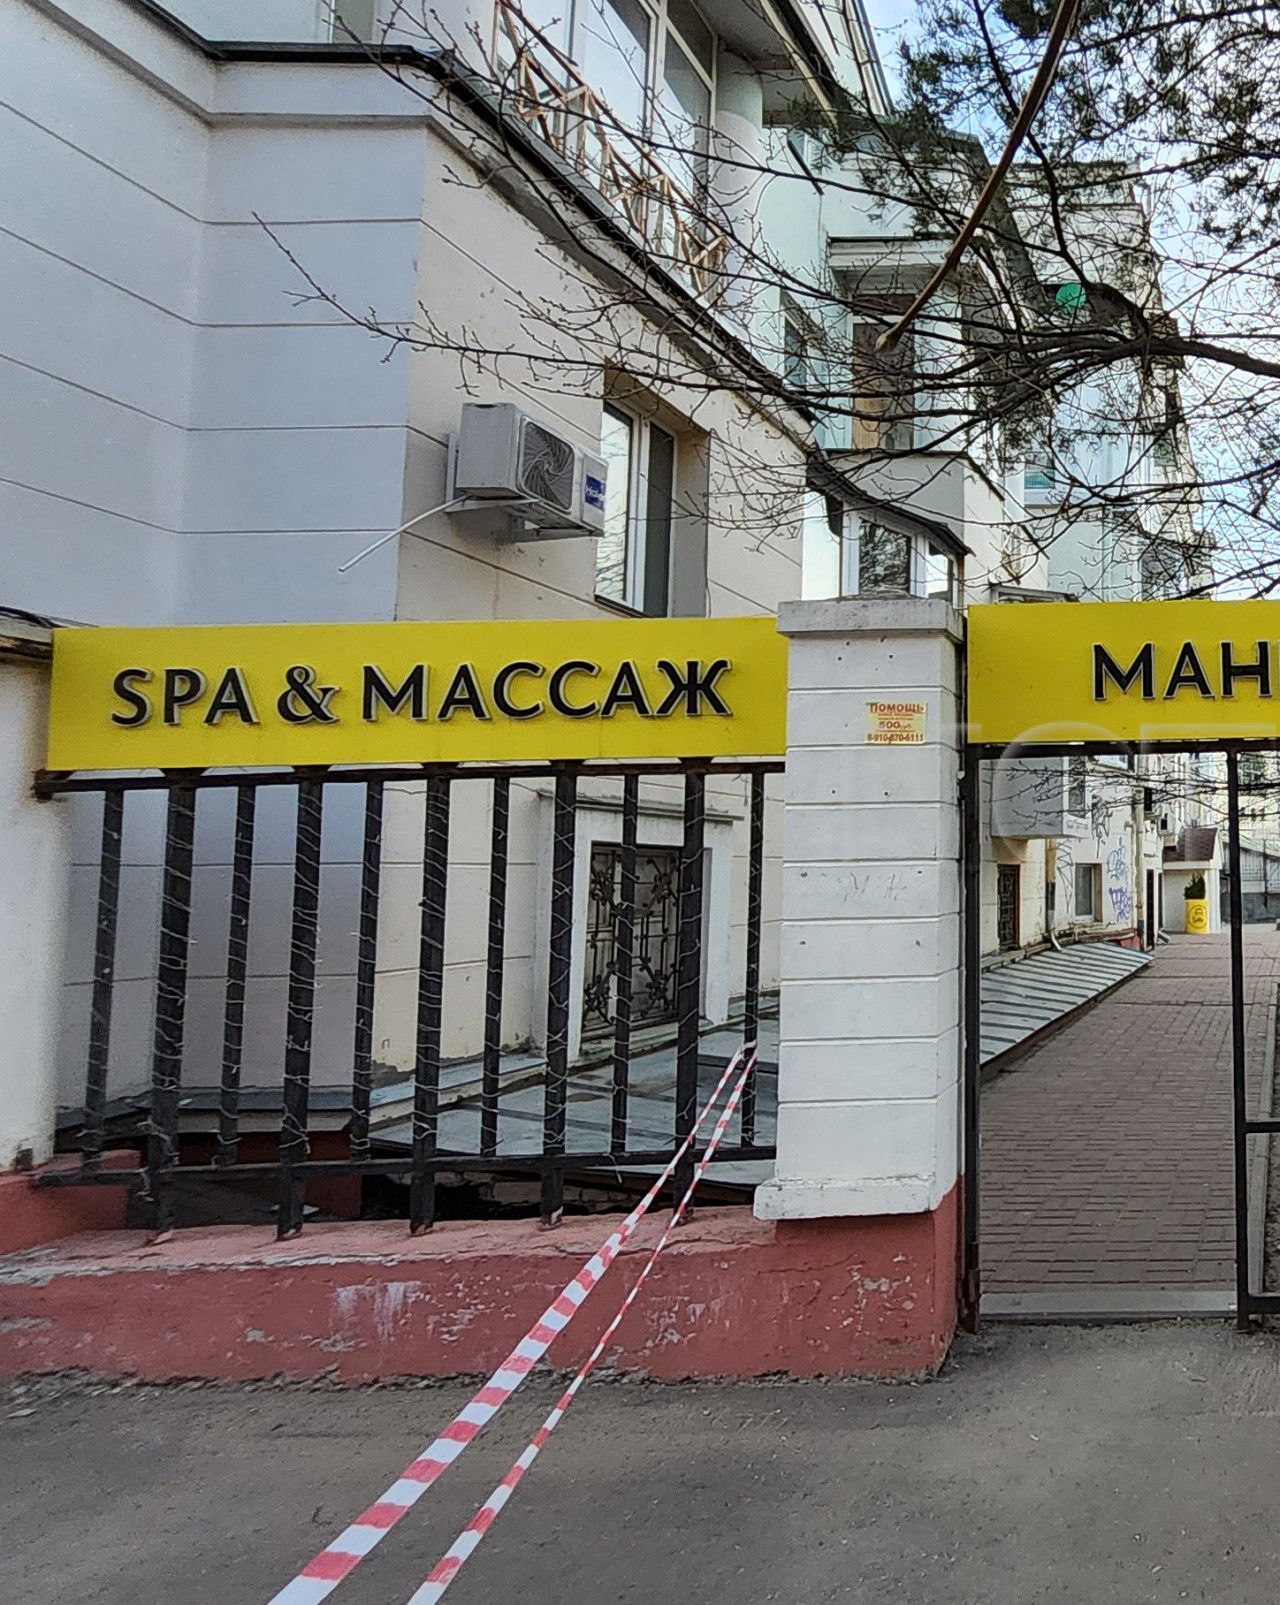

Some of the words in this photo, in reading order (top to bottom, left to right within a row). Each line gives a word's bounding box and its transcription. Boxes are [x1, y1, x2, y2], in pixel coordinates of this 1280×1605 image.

[110, 665, 260, 727] SPA
[277, 664, 338, 724] &
[362, 658, 733, 722] МАССАЖ
[869, 703, 925, 713] ПОМОЩЬ
